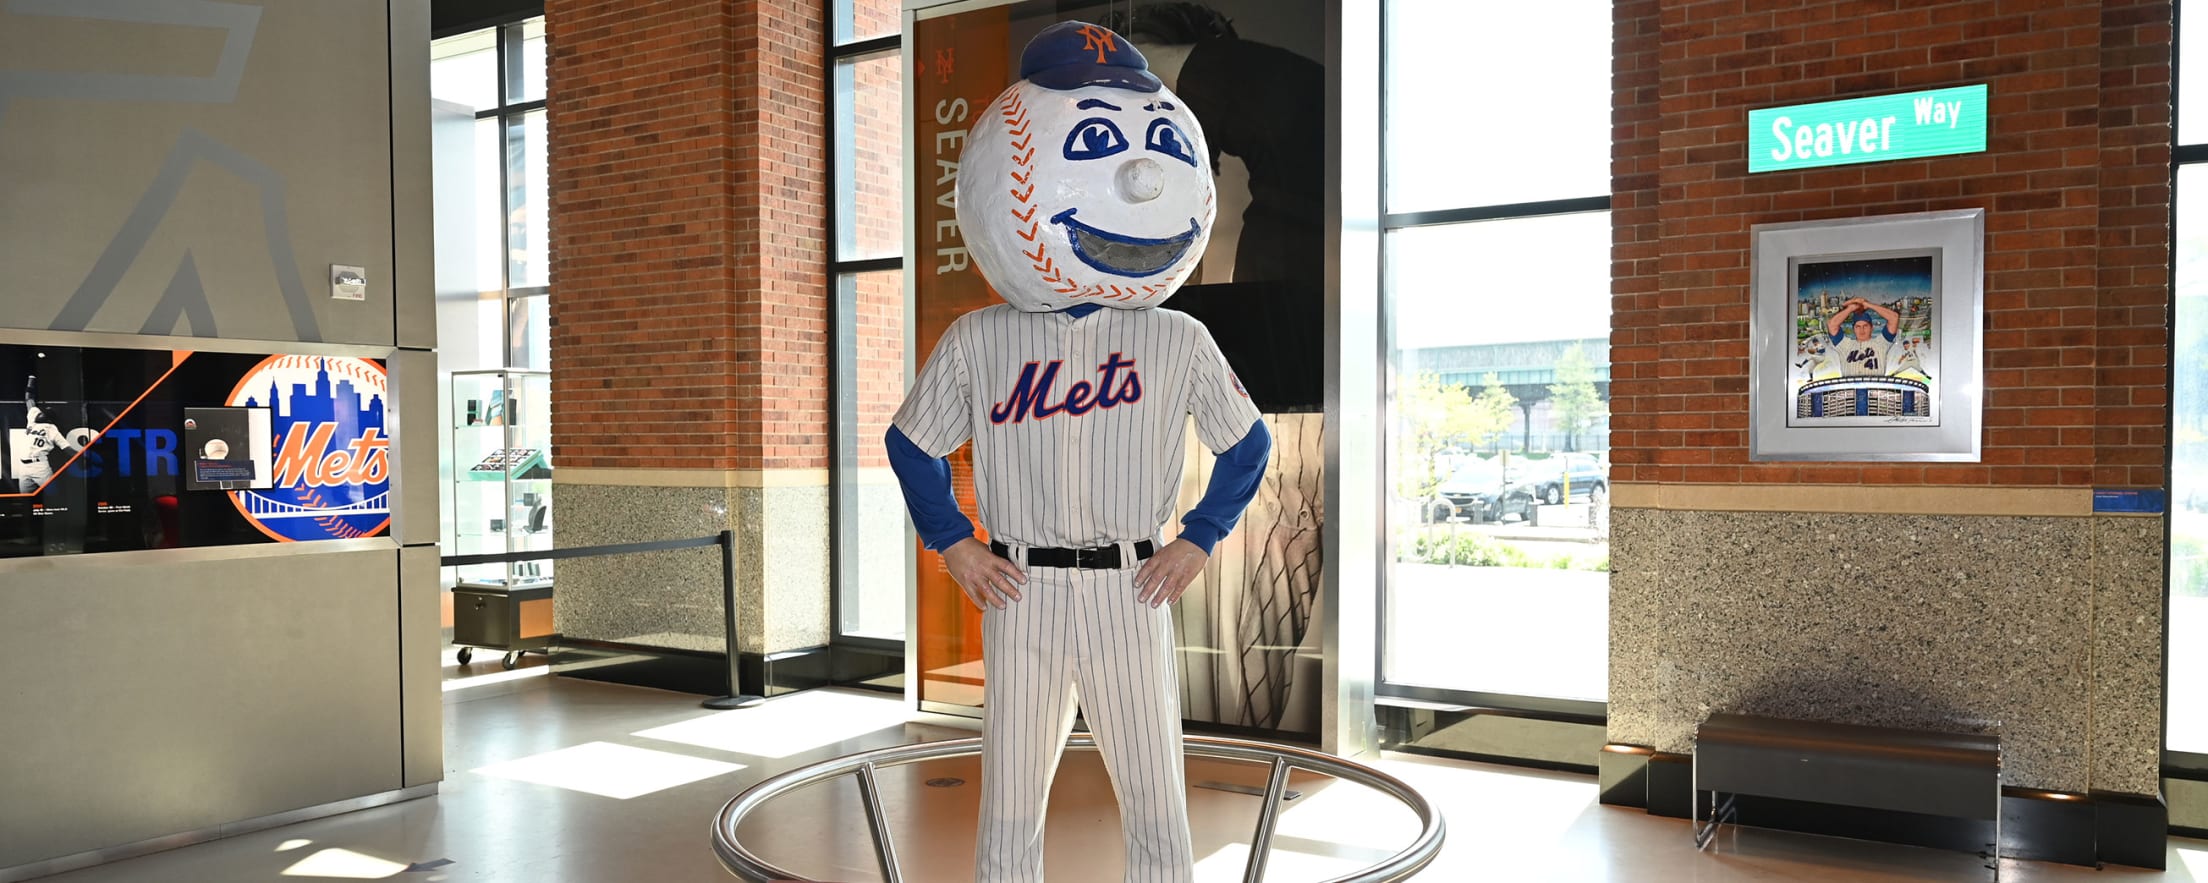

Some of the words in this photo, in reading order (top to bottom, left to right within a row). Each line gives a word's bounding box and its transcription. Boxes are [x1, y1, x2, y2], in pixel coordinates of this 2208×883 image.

[1771, 116, 1896, 161] Seaver
[1913, 97, 1962, 129] Way
[935, 97, 969, 275] SEAVER
[990, 352, 1142, 425] Mets
[1864, 357, 1878, 370] 41
[33, 437, 46, 447] 10
[273, 421, 390, 488] Mets
